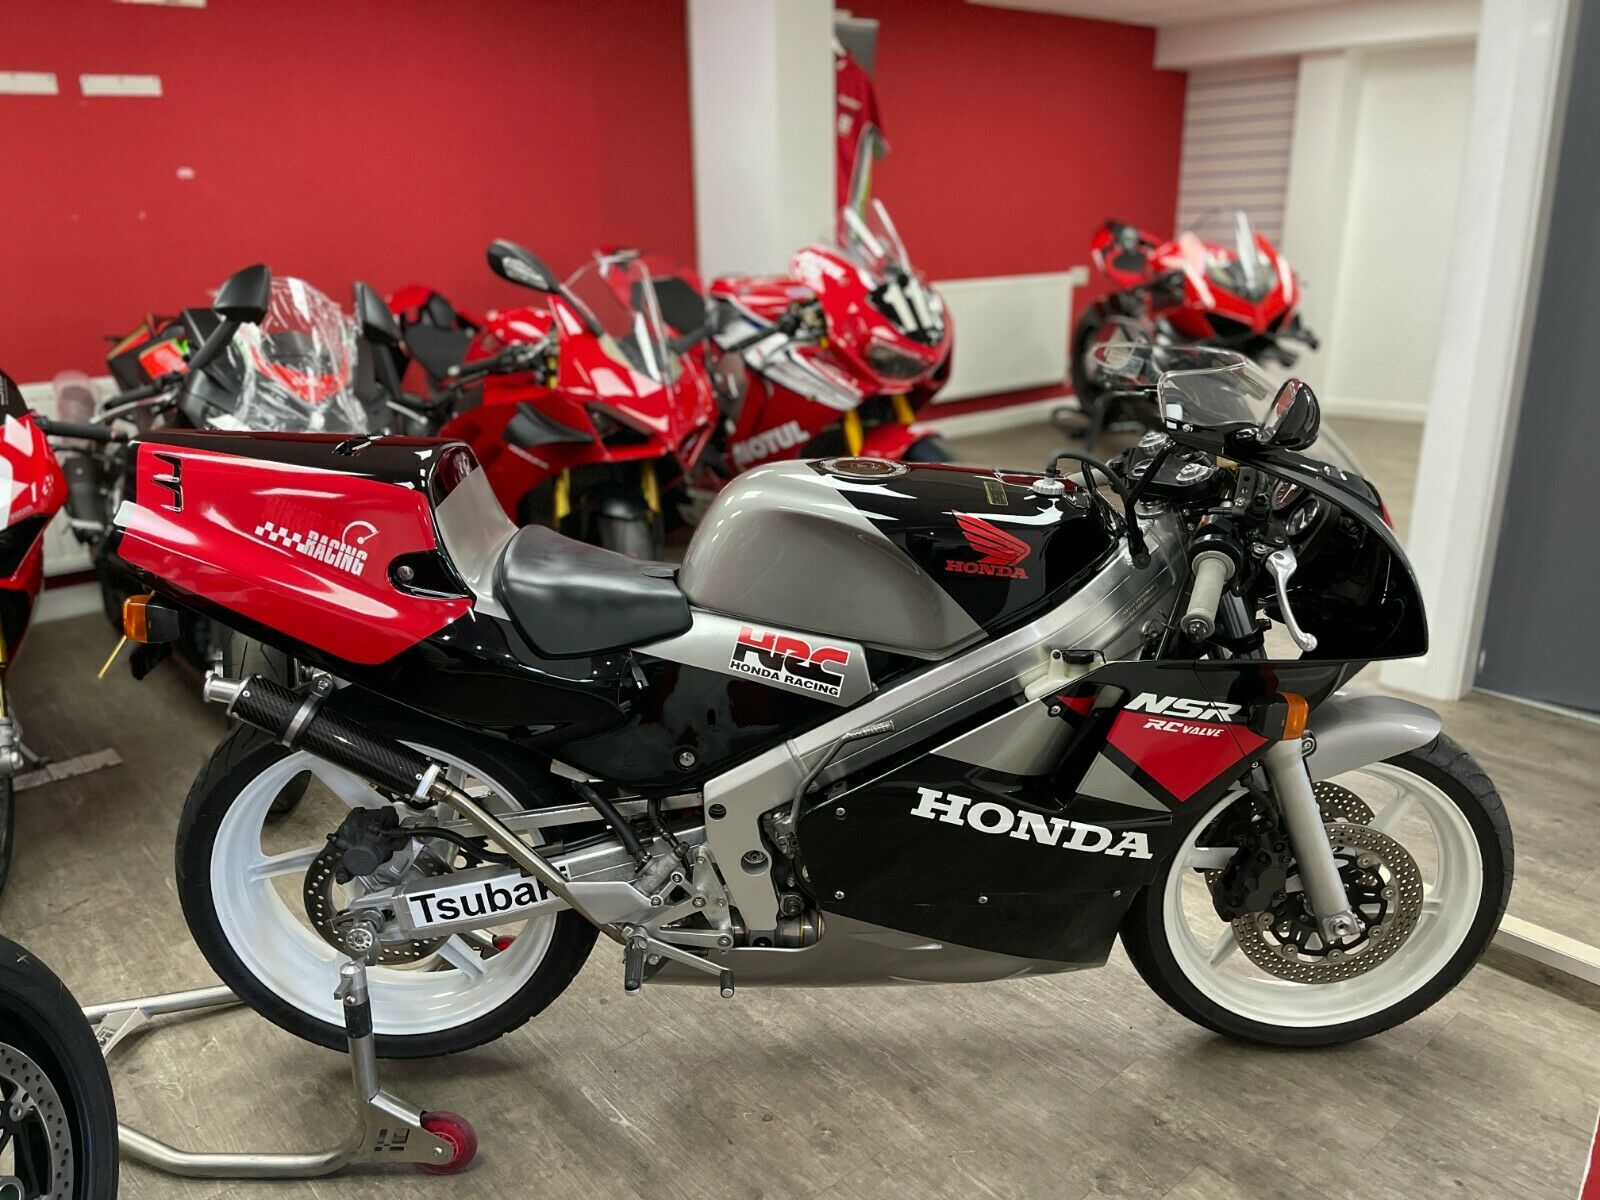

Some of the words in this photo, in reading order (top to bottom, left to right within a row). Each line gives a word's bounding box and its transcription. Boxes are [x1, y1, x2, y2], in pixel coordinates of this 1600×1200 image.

[731, 419, 812, 465] MOTUL
[303, 529, 369, 576] RACING
[945, 560, 1029, 579] HONDA
[730, 660, 780, 680] HONDA
[784, 675, 839, 696] RACING
[732, 624, 851, 687] HRC
[1123, 692, 1242, 722] NSR
[910, 786, 1154, 860] HONDA
